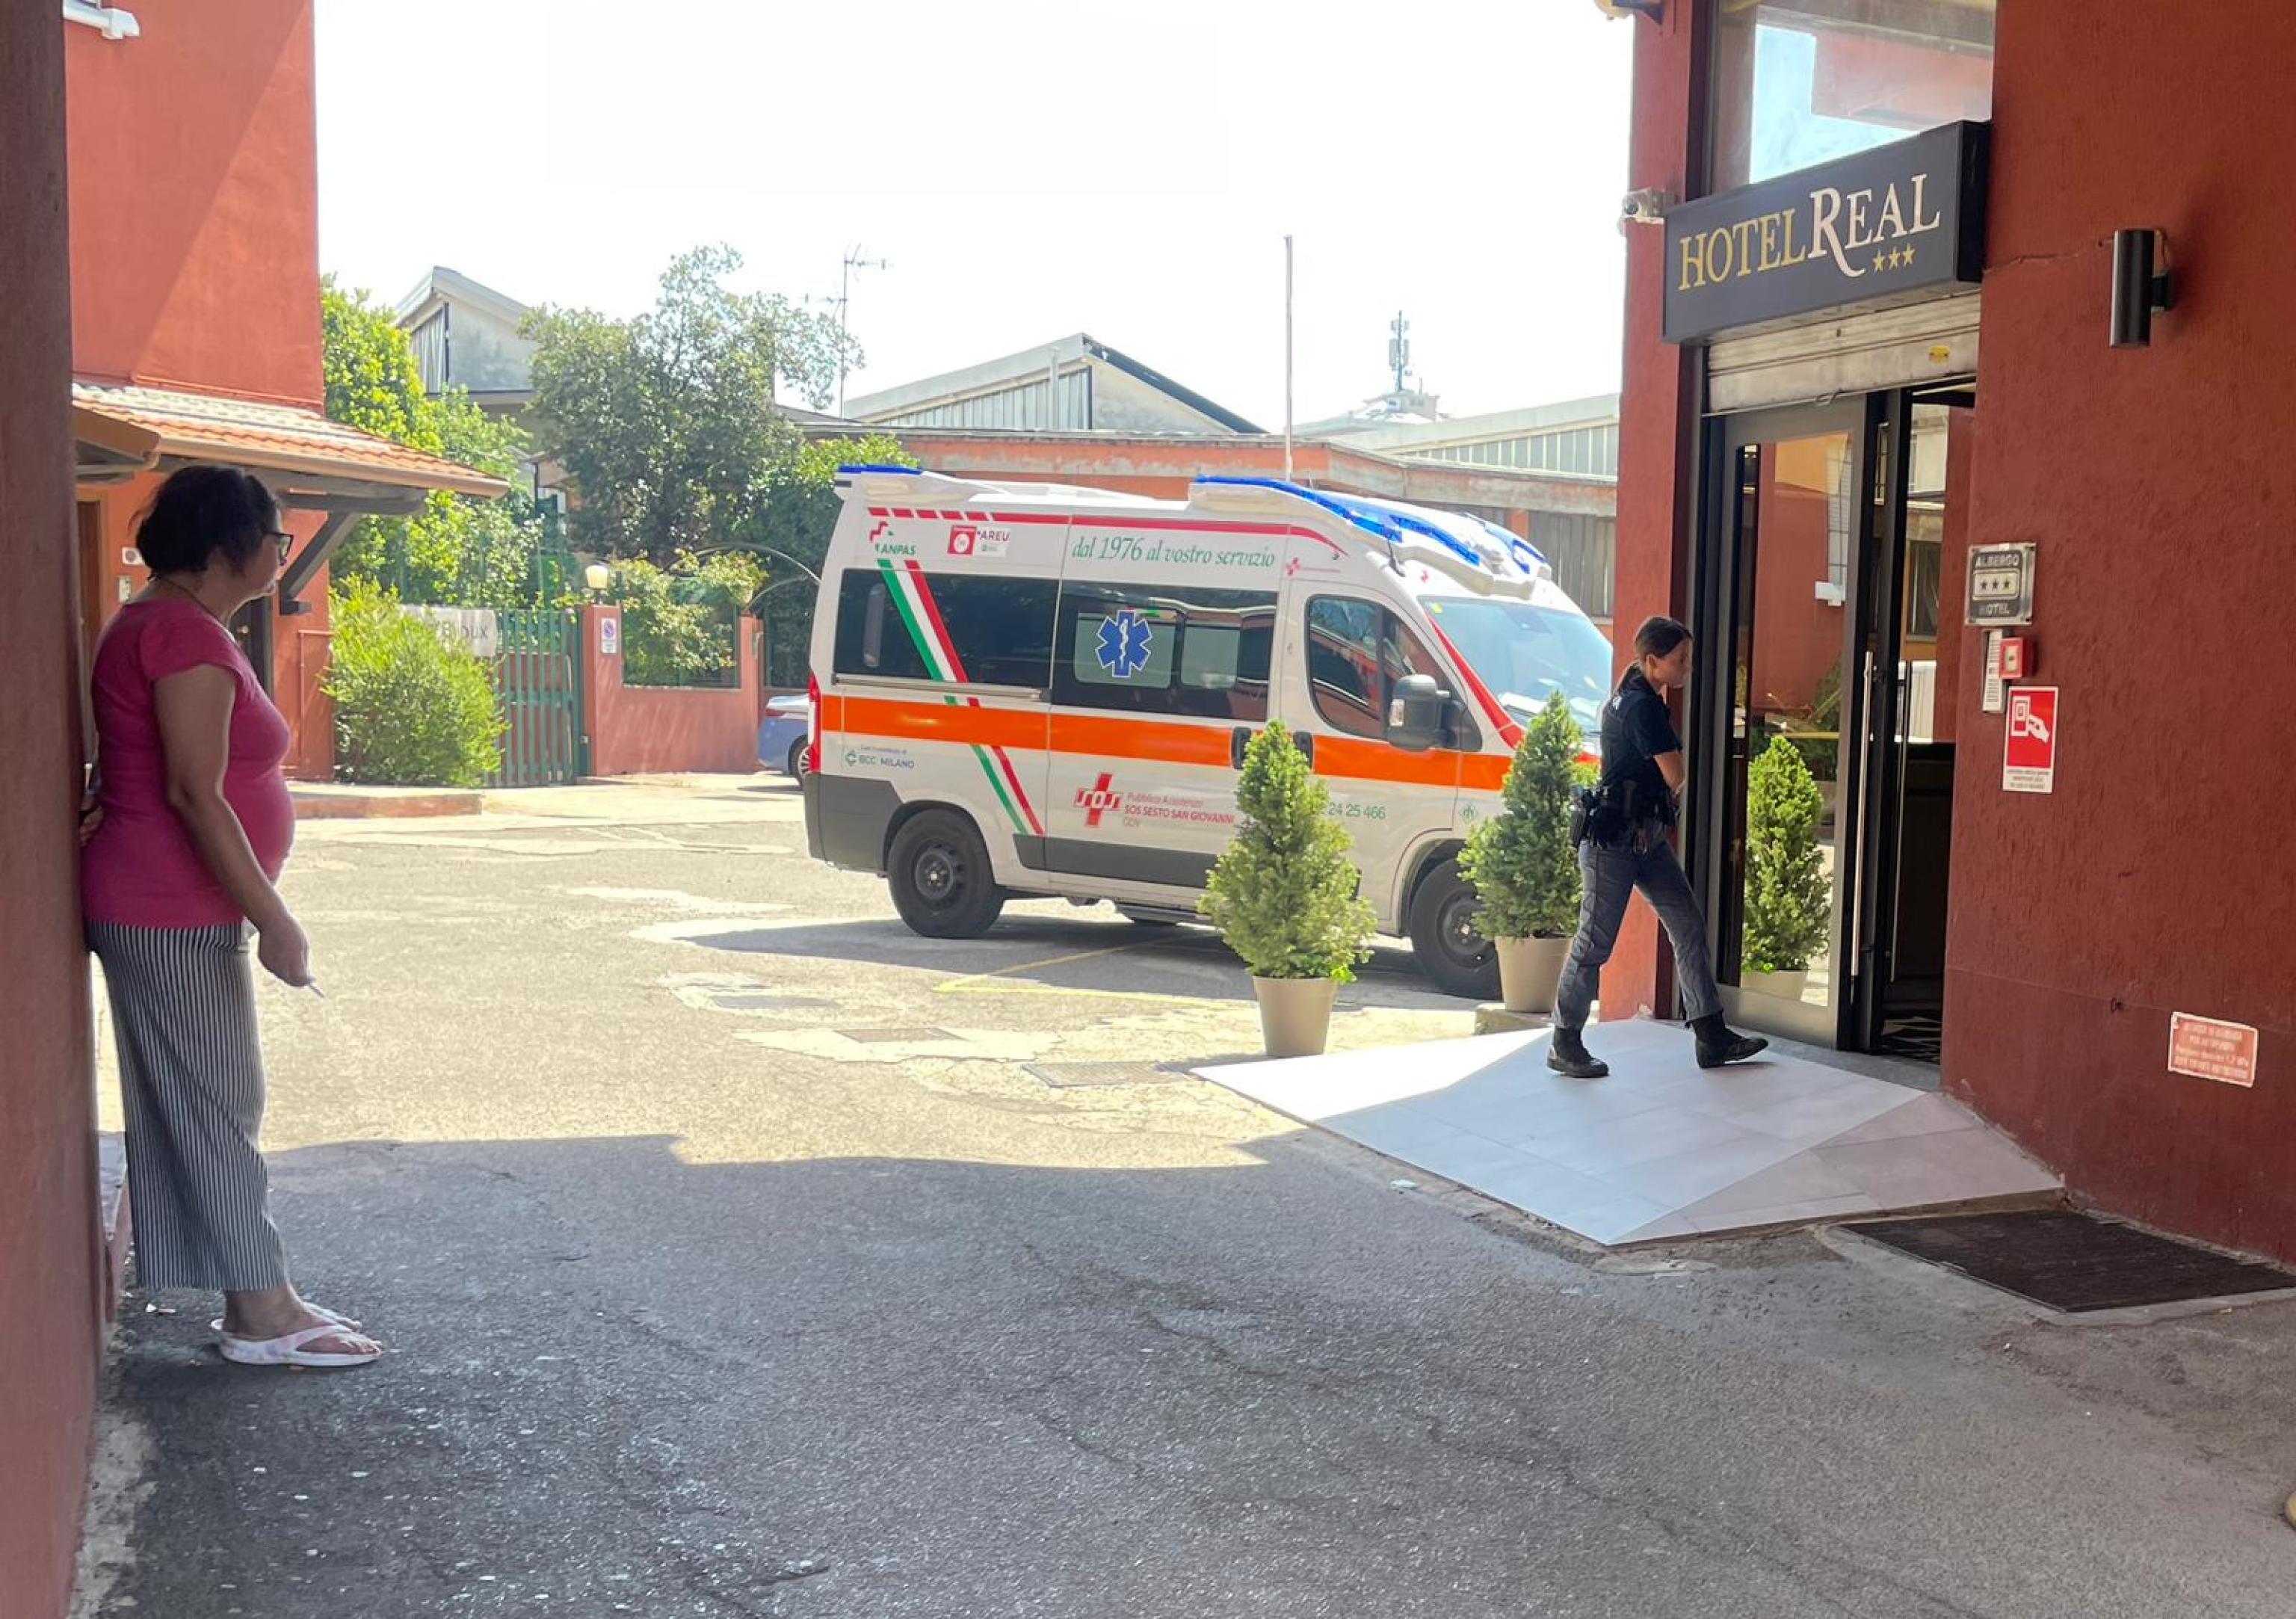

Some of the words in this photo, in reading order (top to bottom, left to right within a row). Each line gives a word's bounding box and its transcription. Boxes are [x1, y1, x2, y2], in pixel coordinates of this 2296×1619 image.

[1678, 208, 1806, 291] HOTEL
[1807, 173, 1941, 278] REAL
[979, 530, 1010, 542] AREU
[882, 543, 917, 555] ANPAS
[1072, 535, 1095, 559] dal
[1099, 537, 1143, 562] 1976
[1147, 541, 1162, 562] al
[1164, 544, 1212, 564] vostro
[1215, 546, 1276, 568] servizio
[1975, 553, 2020, 568] ALBERGO
[880, 757, 915, 769] MILANO
[1124, 804, 1142, 815] SOS
[1143, 806, 1169, 818] SESTO
[1171, 810, 1190, 820] SAN
[1327, 801, 1342, 816] 24
[1345, 803, 1361, 818] 25
[1363, 804, 1386, 820] 466
